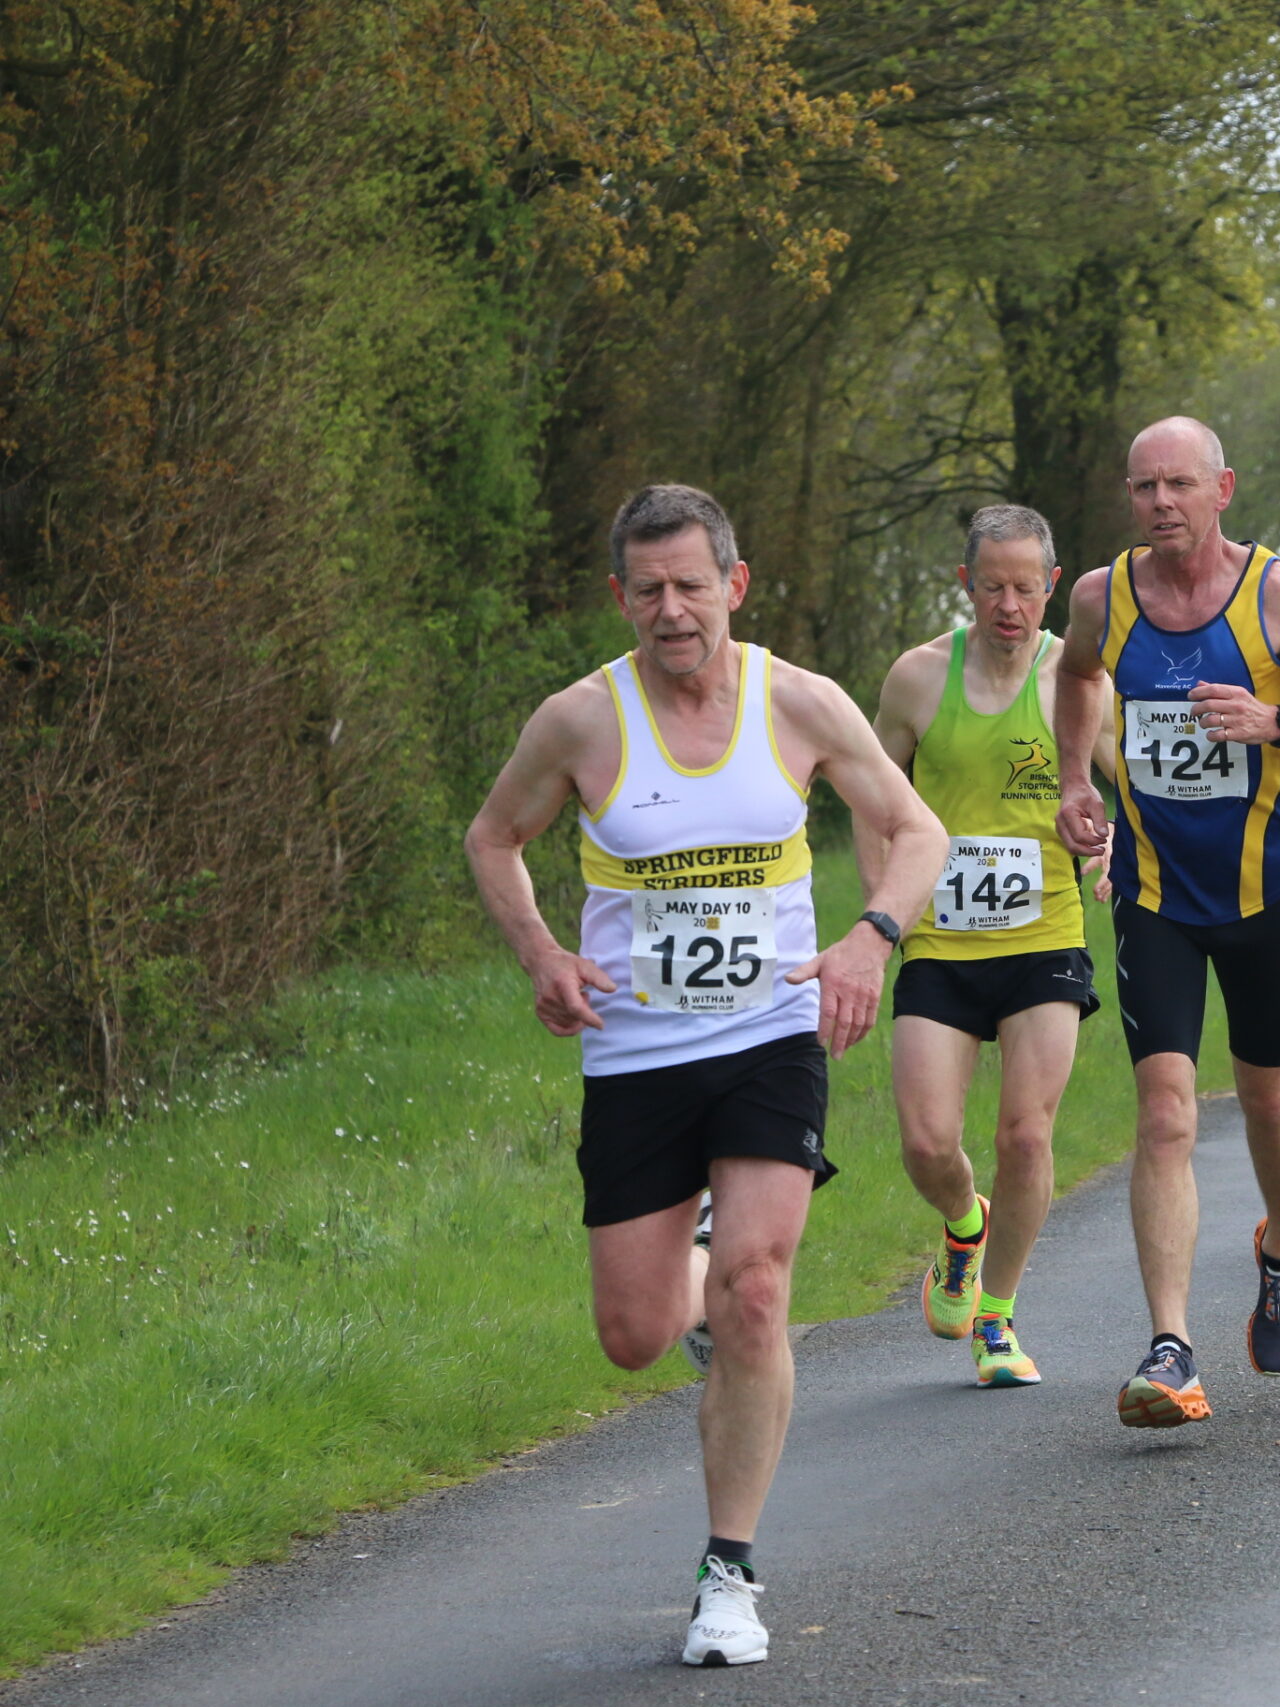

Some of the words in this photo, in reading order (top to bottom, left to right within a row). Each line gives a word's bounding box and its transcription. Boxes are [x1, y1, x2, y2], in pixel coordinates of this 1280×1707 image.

[1151, 712, 1177, 723] MAY
[1141, 739, 1234, 781] 124
[1177, 785, 1212, 793] WITHAM
[1000, 792, 1042, 801] RUNNING
[958, 846, 981, 857] MAY
[983, 847, 1006, 857] DAY
[1009, 848, 1022, 858] 10
[624, 844, 783, 875] SPRINGFIELD
[644, 869, 765, 890] STRIDERS
[946, 871, 1031, 912] 142
[666, 902, 698, 914] MAY
[702, 902, 731, 915] DAY
[735, 902, 751, 914] 10
[978, 915, 1010, 923] WITHAM
[651, 934, 762, 988] 125
[691, 995, 735, 1003] WITHAM
